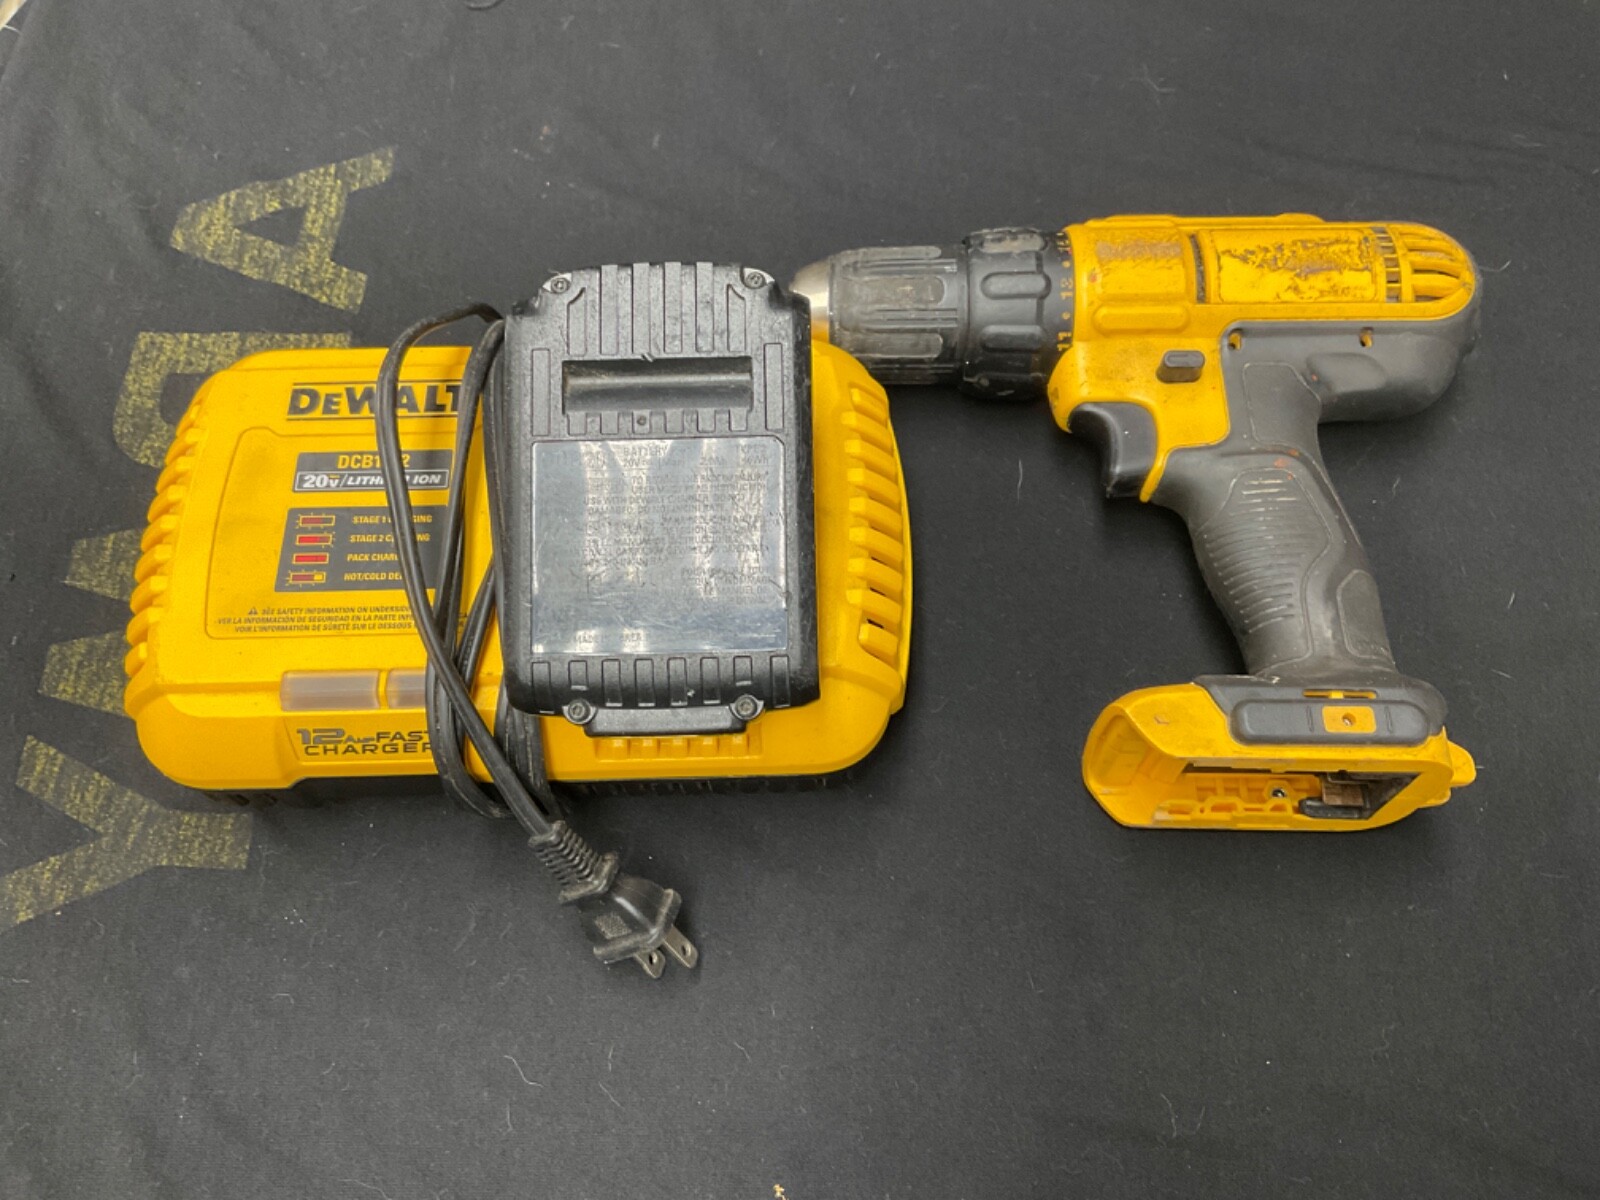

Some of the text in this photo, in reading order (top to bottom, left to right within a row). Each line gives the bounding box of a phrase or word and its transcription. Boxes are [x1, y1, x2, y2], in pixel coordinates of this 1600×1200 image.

[338, 454, 411, 469] DCB12
[413, 474, 441, 484] ION
[353, 515, 379, 524] STAGE
[350, 534, 376, 543] STAGE
[347, 553, 369, 562] PACK
